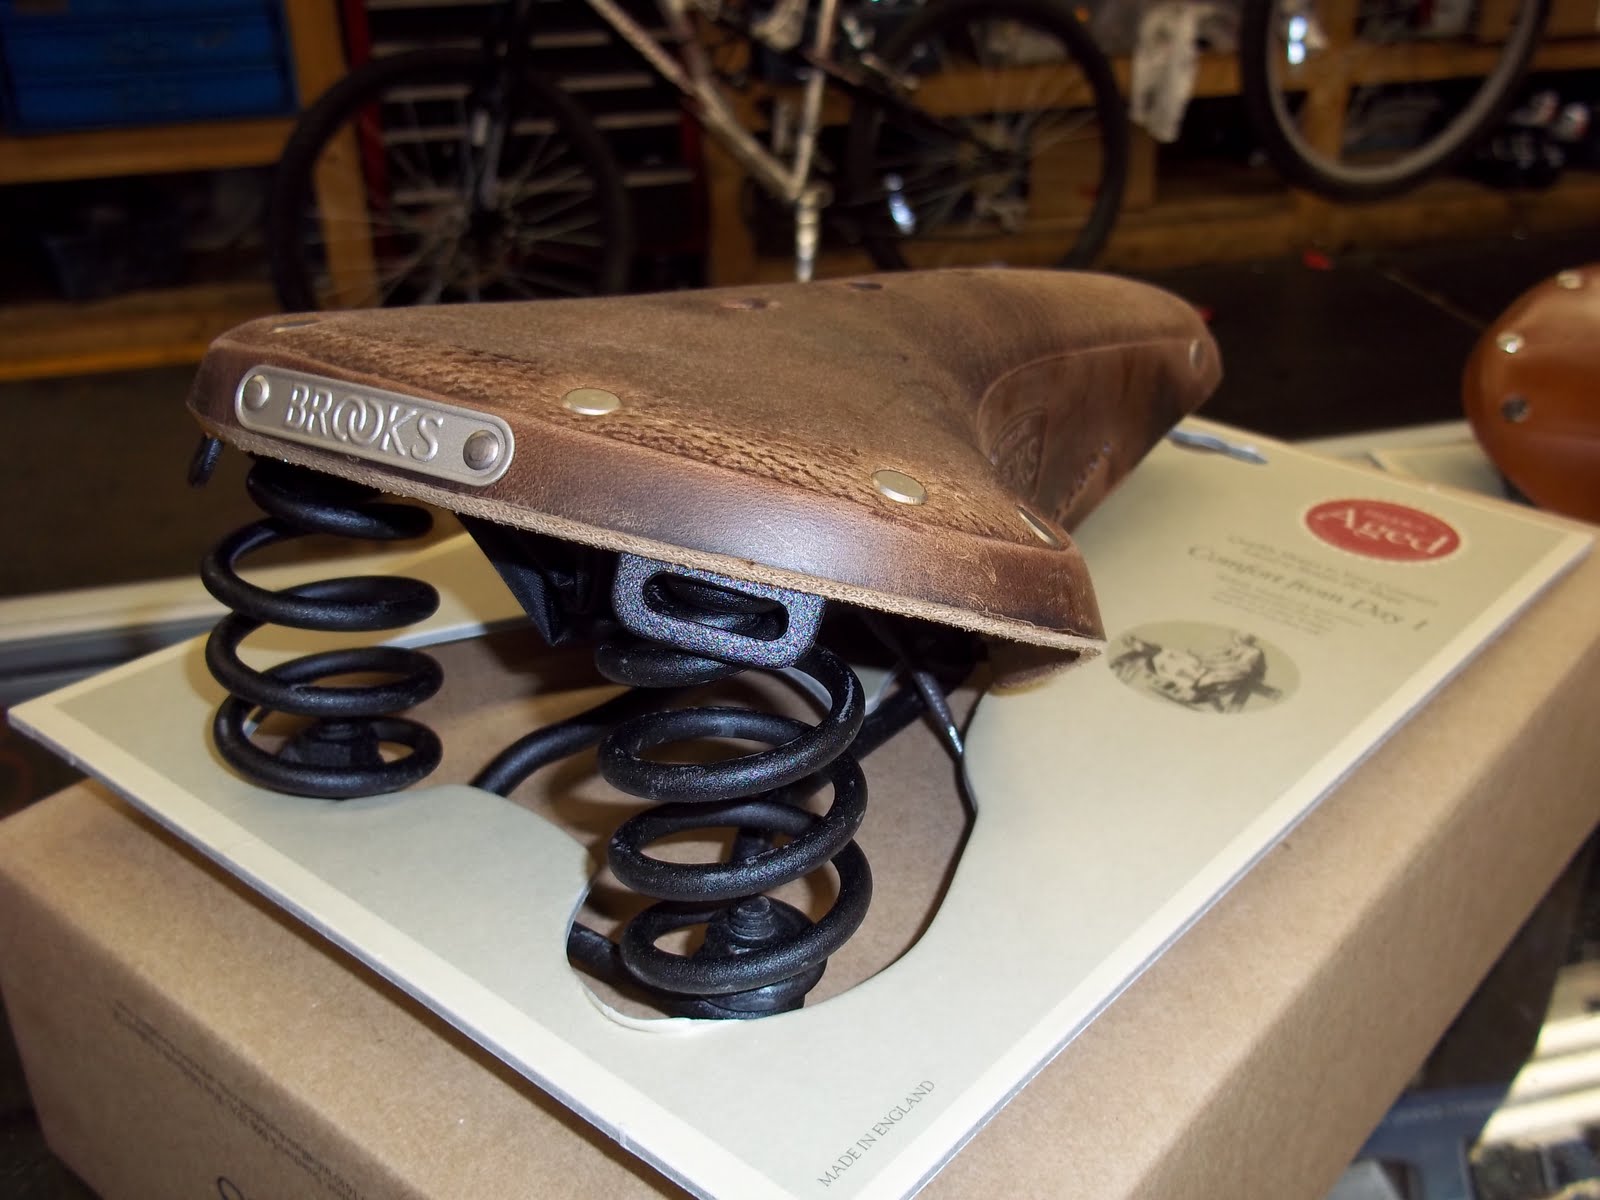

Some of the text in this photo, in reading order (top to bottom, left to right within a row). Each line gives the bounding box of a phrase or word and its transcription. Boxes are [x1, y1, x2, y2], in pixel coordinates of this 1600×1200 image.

[284, 383, 445, 462] BROOKS
[1314, 507, 1449, 554] Aged
[817, 1080, 935, 1187] MADE IN ENGLAND
